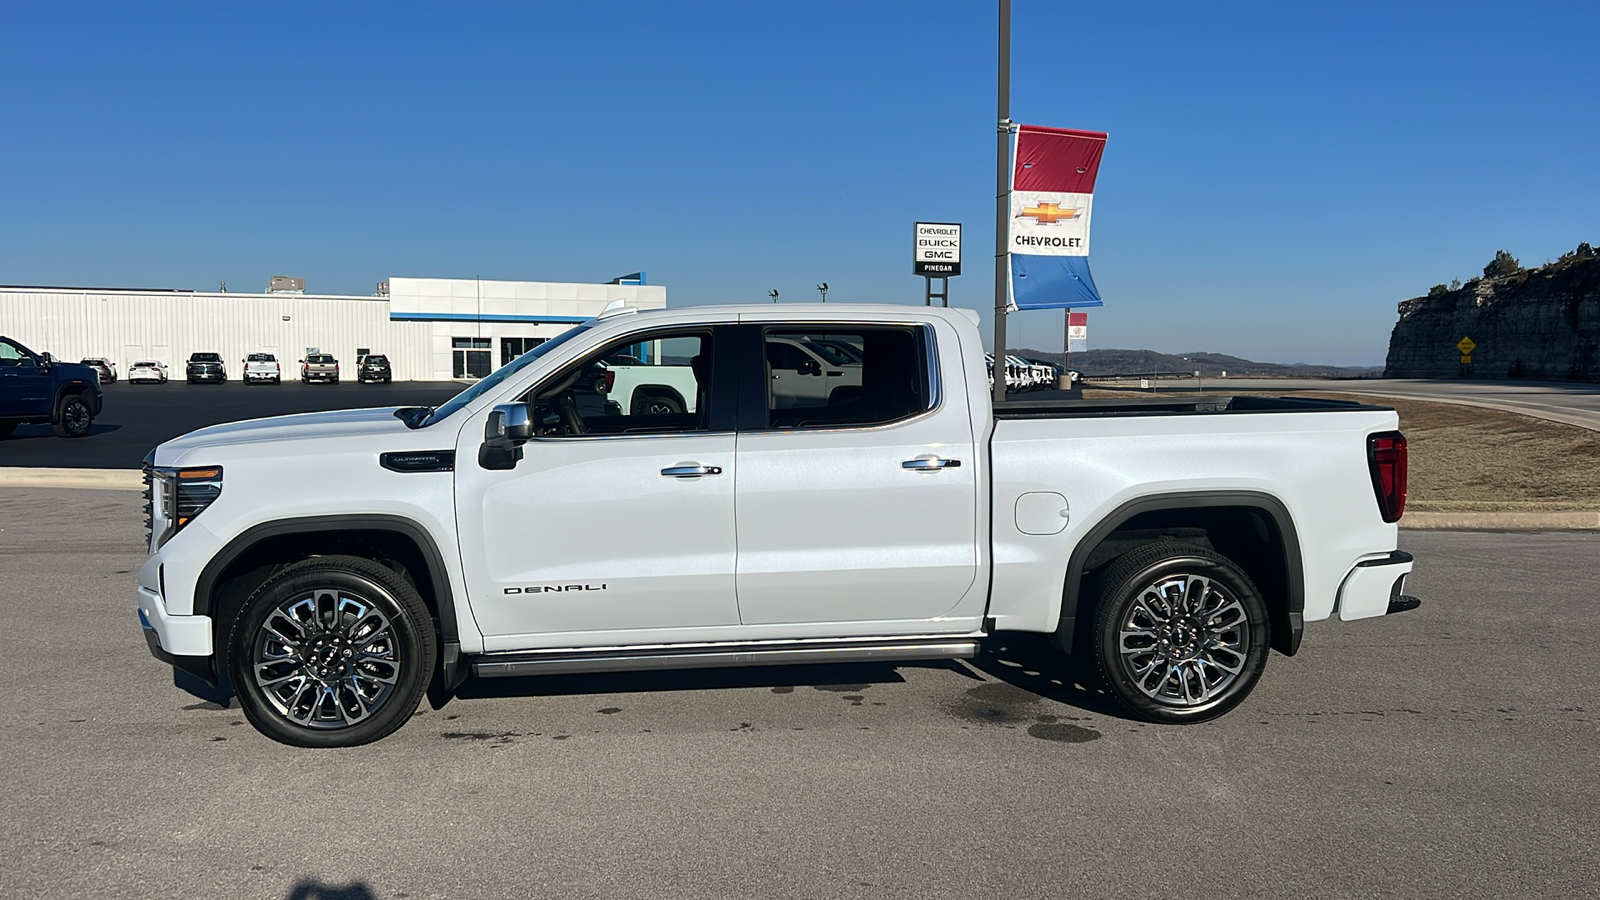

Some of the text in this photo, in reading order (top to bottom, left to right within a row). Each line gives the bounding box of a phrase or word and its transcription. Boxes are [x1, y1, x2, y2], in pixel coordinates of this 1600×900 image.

[919, 239, 958, 247] BUICK
[1015, 235, 1081, 248] CHEVROLET
[924, 251, 953, 259] GMC
[503, 583, 607, 595] DENALI
